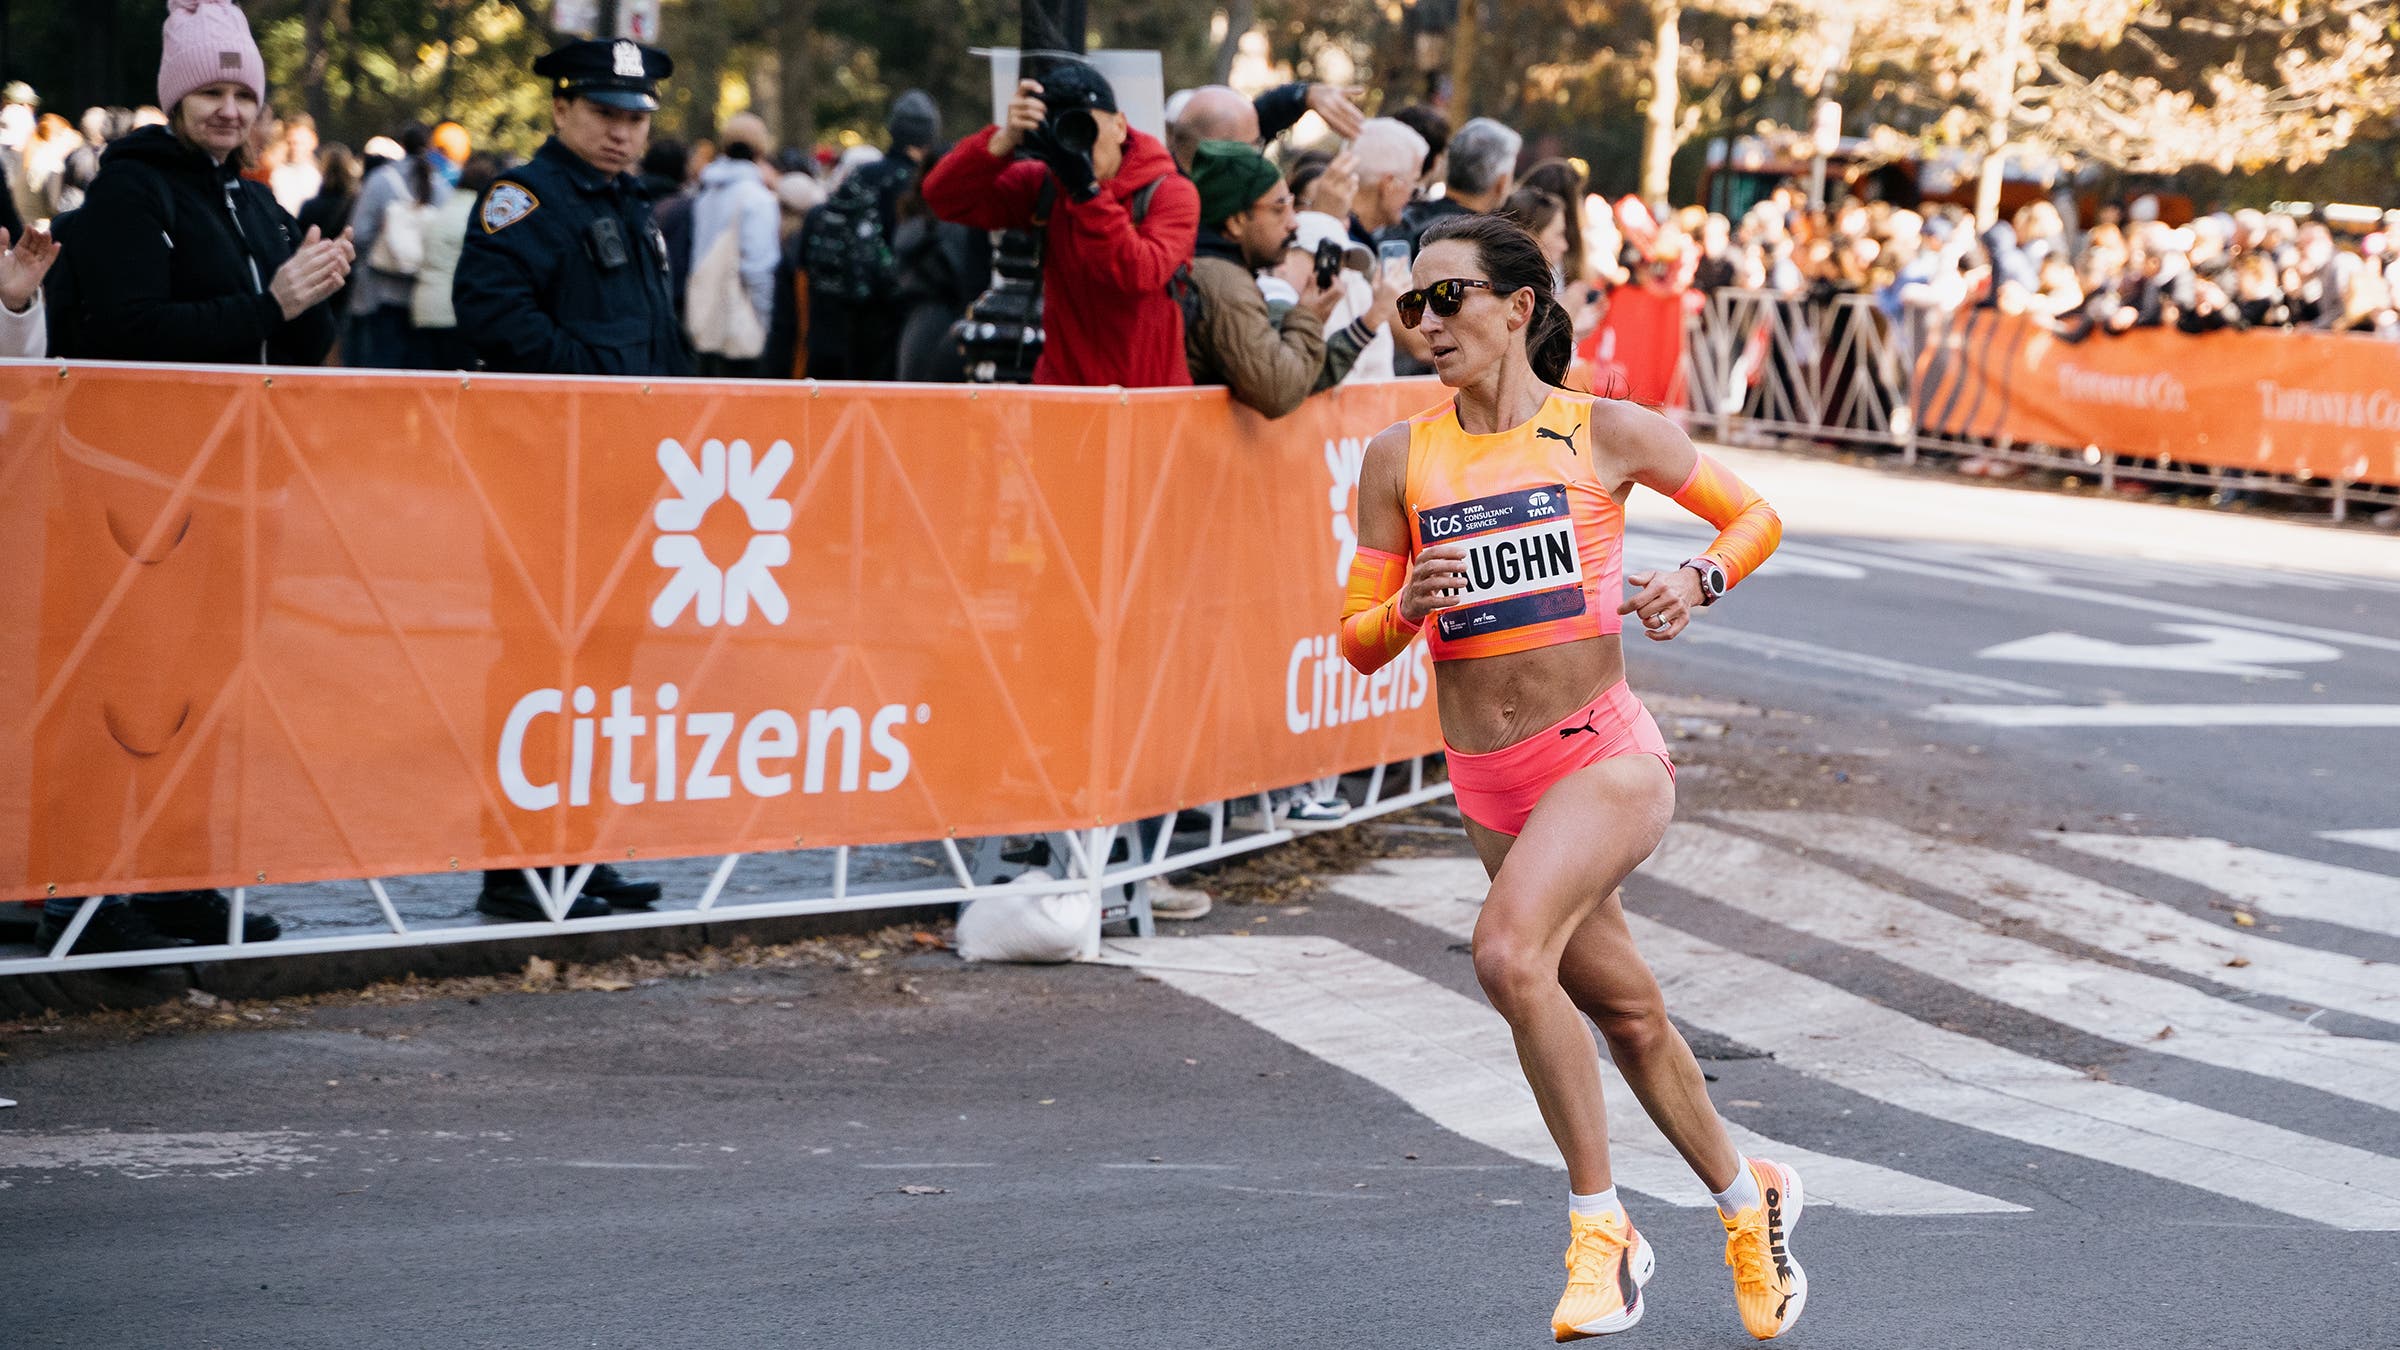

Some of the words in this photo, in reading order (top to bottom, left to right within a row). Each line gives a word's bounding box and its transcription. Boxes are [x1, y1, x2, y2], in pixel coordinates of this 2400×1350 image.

[1463, 504, 1485, 515] TATA
[1465, 506, 1514, 523] CONSULTANCY
[1527, 505, 1556, 518] TATA
[1429, 514, 1463, 537] tcs
[1465, 517, 1498, 531] SERVICES
[1442, 530, 1574, 597] AUGHN
[1286, 634, 1429, 734] Citizens
[1765, 1186, 1798, 1287] NITRO
